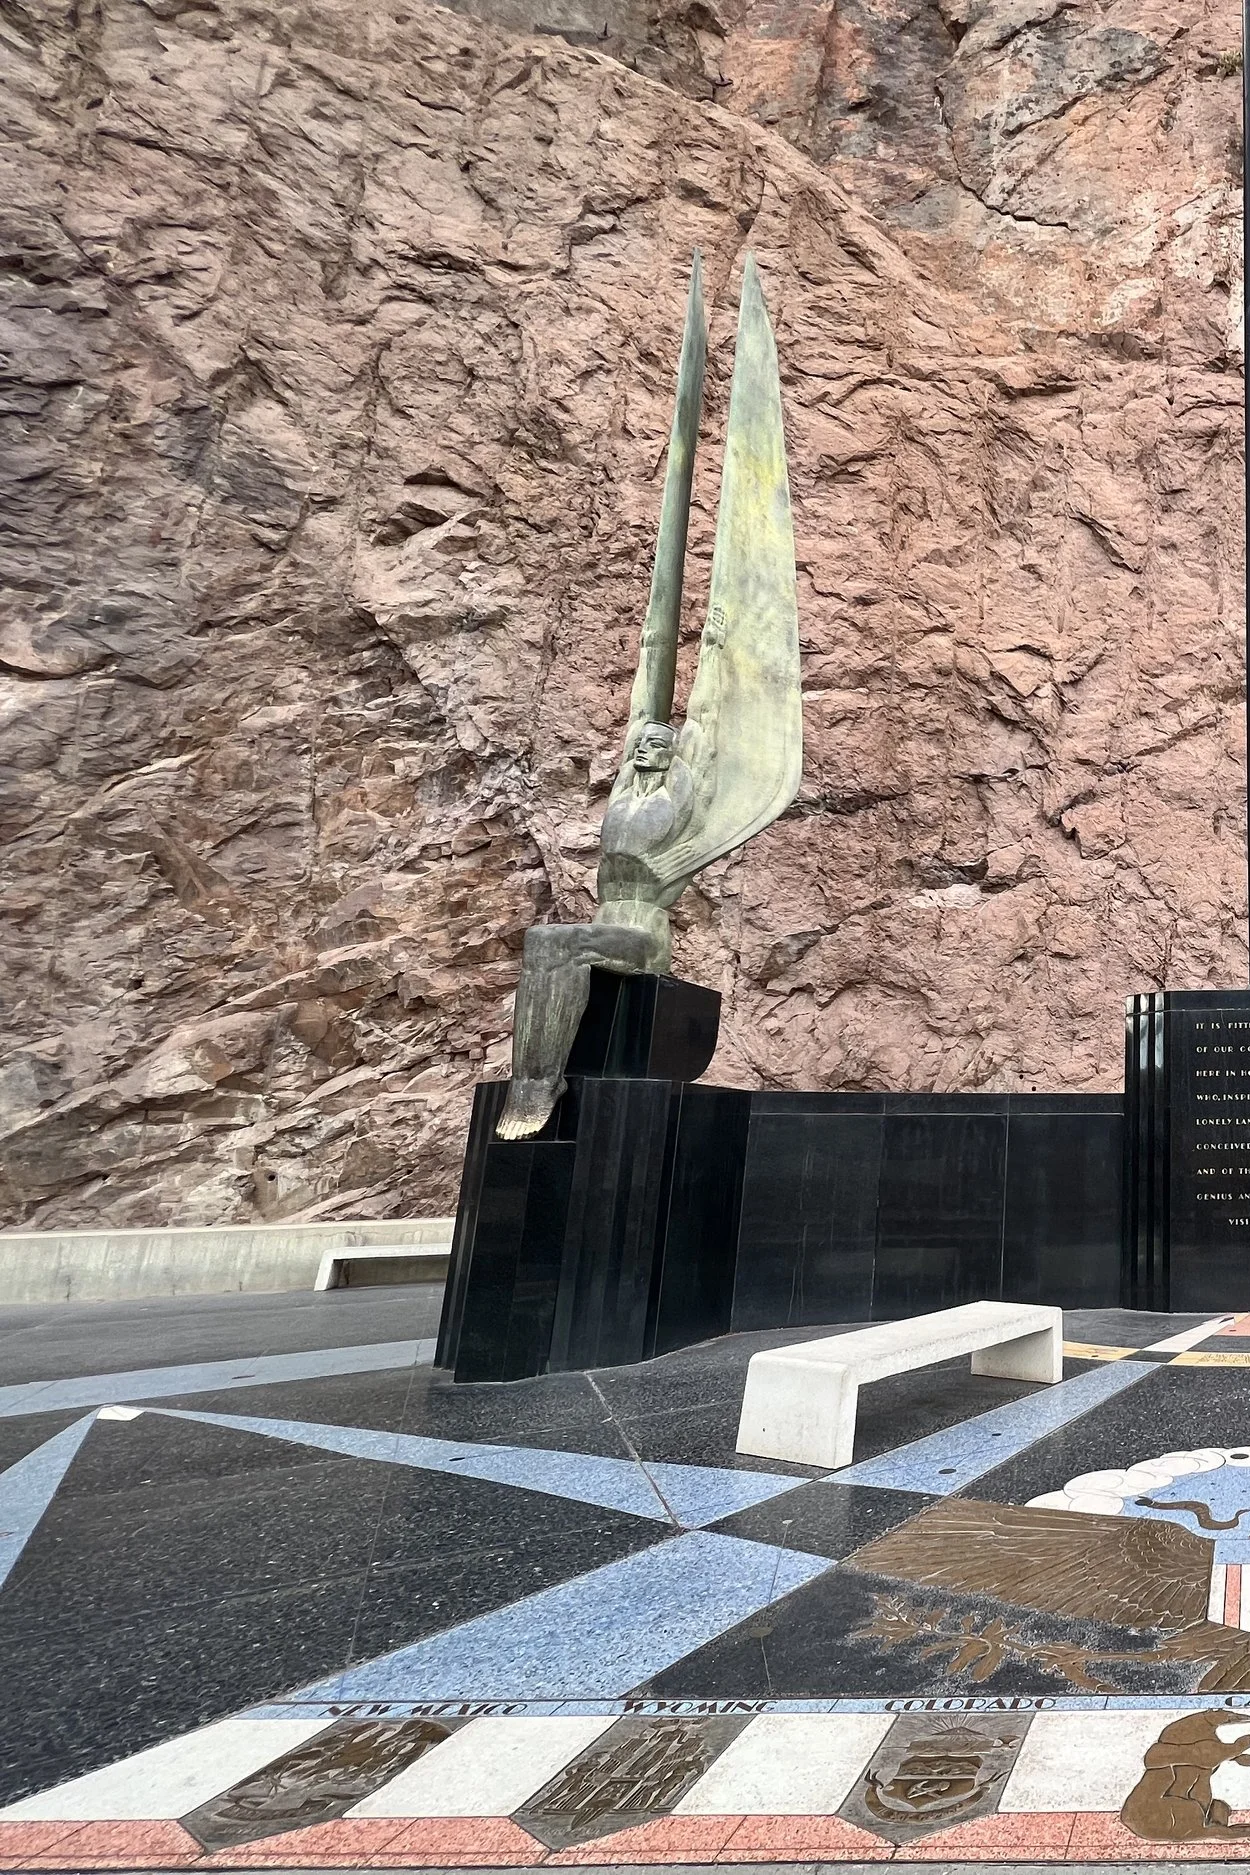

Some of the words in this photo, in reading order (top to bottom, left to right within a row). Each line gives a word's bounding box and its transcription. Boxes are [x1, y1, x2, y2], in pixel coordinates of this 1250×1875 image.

[1196, 1022, 1204, 1030] IT
[1212, 1022, 1220, 1030] IS
[1196, 1046, 1208, 1054] OF
[1214, 1045, 1233, 1053] OUR
[1226, 1069, 1236, 1077] IN
[1196, 1117, 1232, 1126] LONELY
[1197, 1167, 1215, 1176] AND
[1222, 1167, 1233, 1175] OF
[1197, 1192, 1233, 1201] GENIUS
[624, 1700, 778, 1714] WYOMING
[884, 1698, 1057, 1711] COLORADO
[318, 1704, 400, 1717] NEW
[401, 1703, 528, 1717] MEXICO
